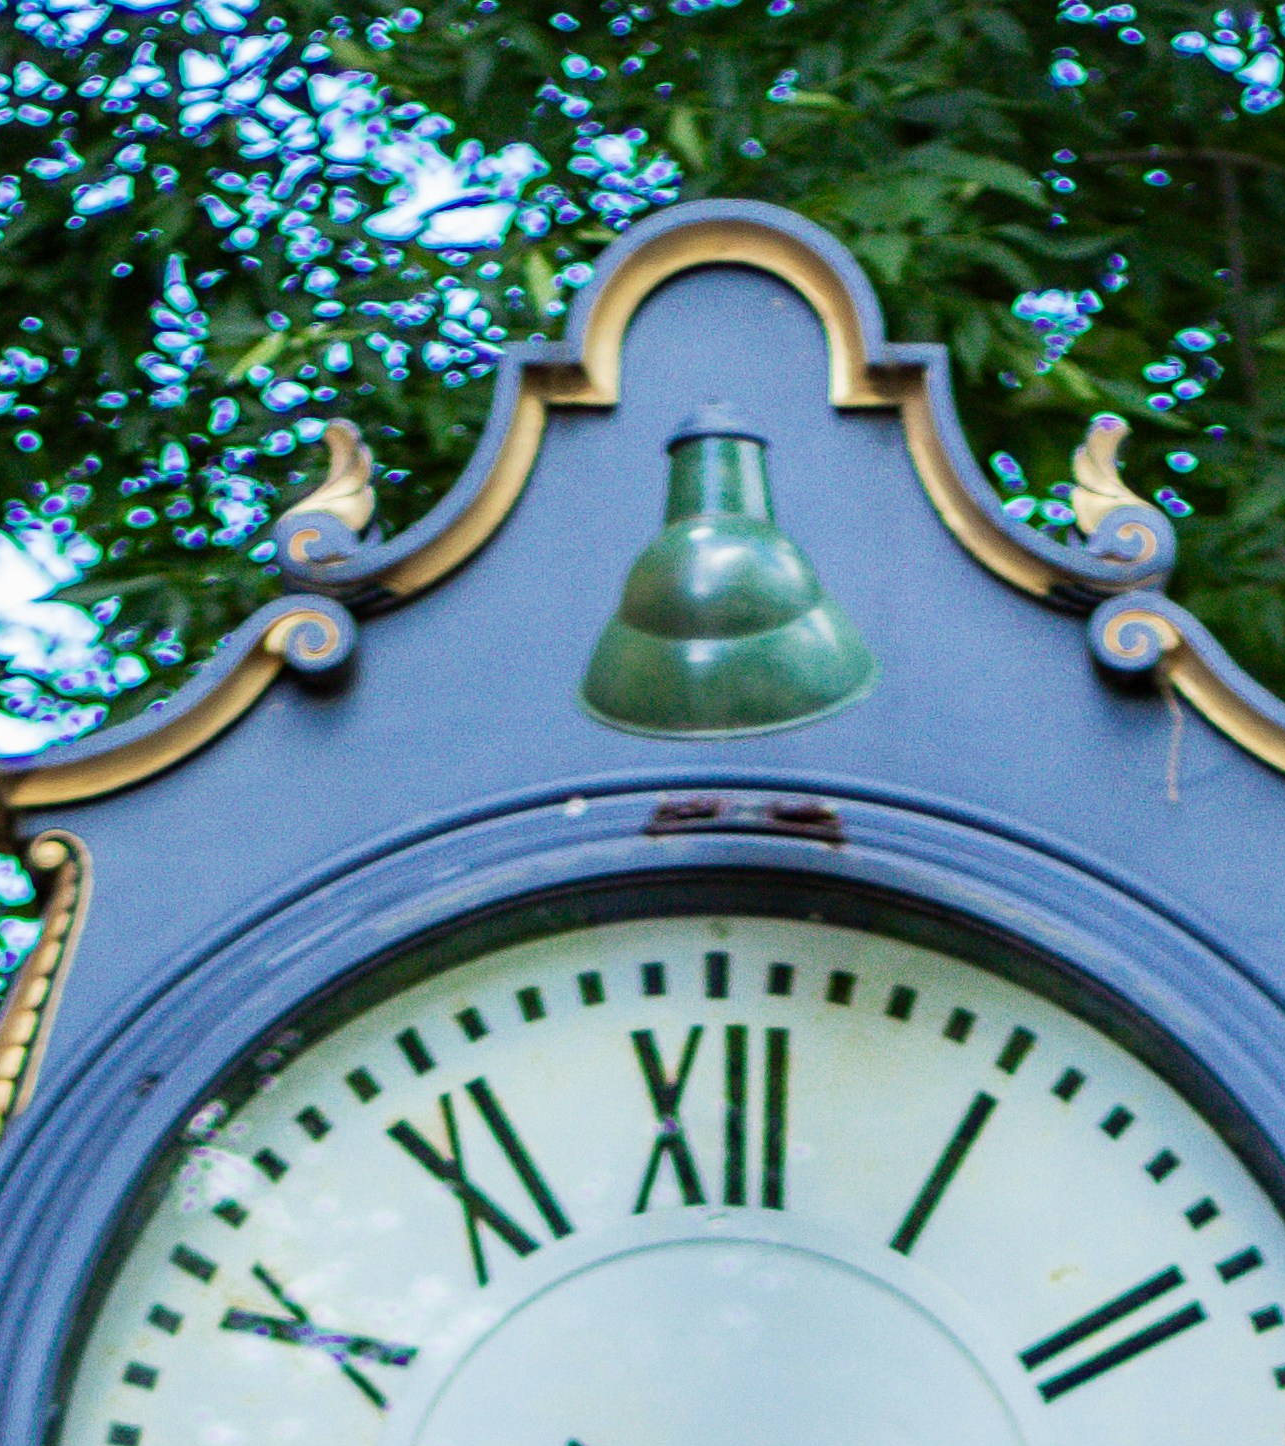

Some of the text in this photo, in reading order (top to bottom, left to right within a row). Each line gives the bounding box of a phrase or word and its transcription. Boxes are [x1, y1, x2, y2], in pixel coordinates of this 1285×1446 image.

[386, 1076, 575, 1287] XI
[630, 1023, 790, 1214] XII
[889, 1090, 999, 1256] I
[220, 1263, 418, 1411] X
[1019, 1264, 1207, 1404] II
